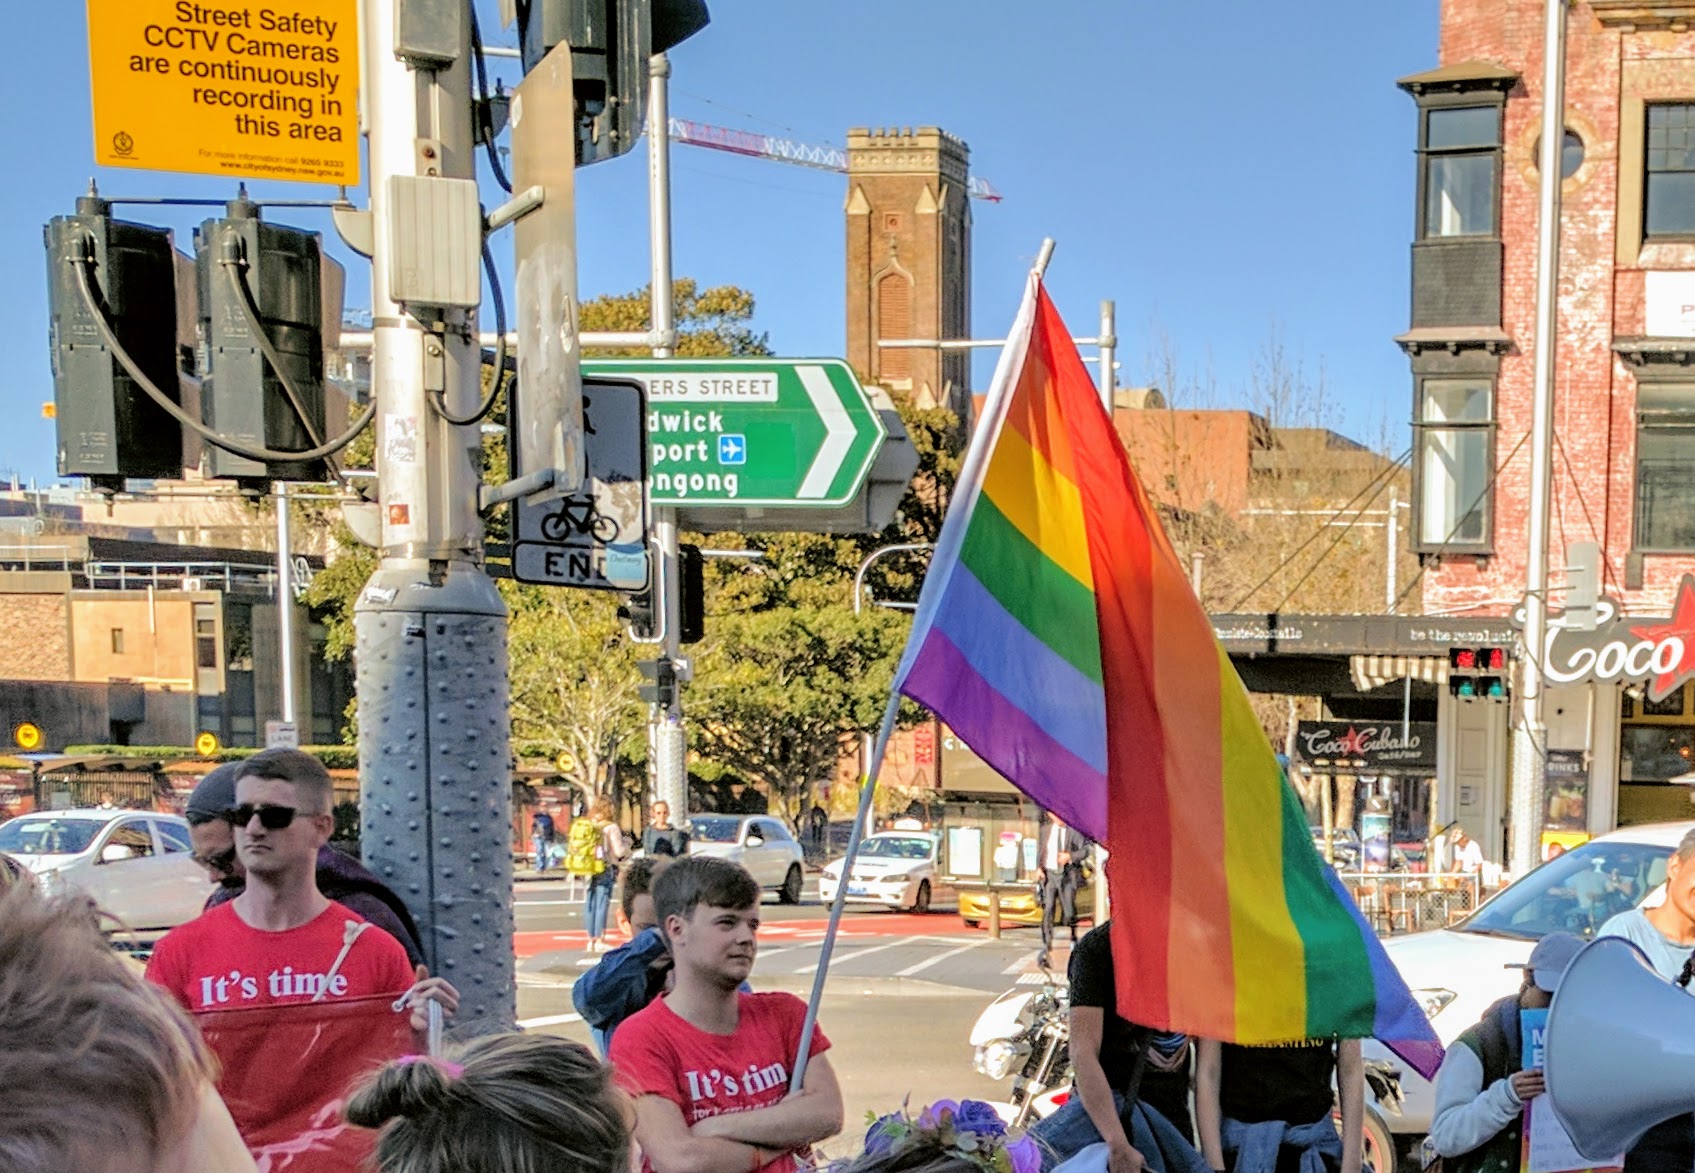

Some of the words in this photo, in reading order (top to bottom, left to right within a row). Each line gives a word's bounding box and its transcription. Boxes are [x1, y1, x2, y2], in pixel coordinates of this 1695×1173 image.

[176, 1, 251, 29] Street
[259, 9, 338, 42] Safety
[144, 25, 219, 51] CCTV
[227, 33, 340, 63] Cameras
[129, 54, 170, 74] are
[178, 59, 340, 95] continuously
[193, 87, 313, 118] recording
[320, 94, 342, 115] in
[235, 114, 280, 137] this
[288, 122, 342, 142] area
[699, 379, 772, 395] STREET
[648, 410, 724, 433] dwick
[1516, 601, 1685, 683] Coco
[1300, 729, 1351, 756] Coco
[200, 970, 259, 1008] It's
[268, 966, 349, 998] time
[685, 1069, 739, 1101] It's
[742, 1063, 787, 1096] tim
